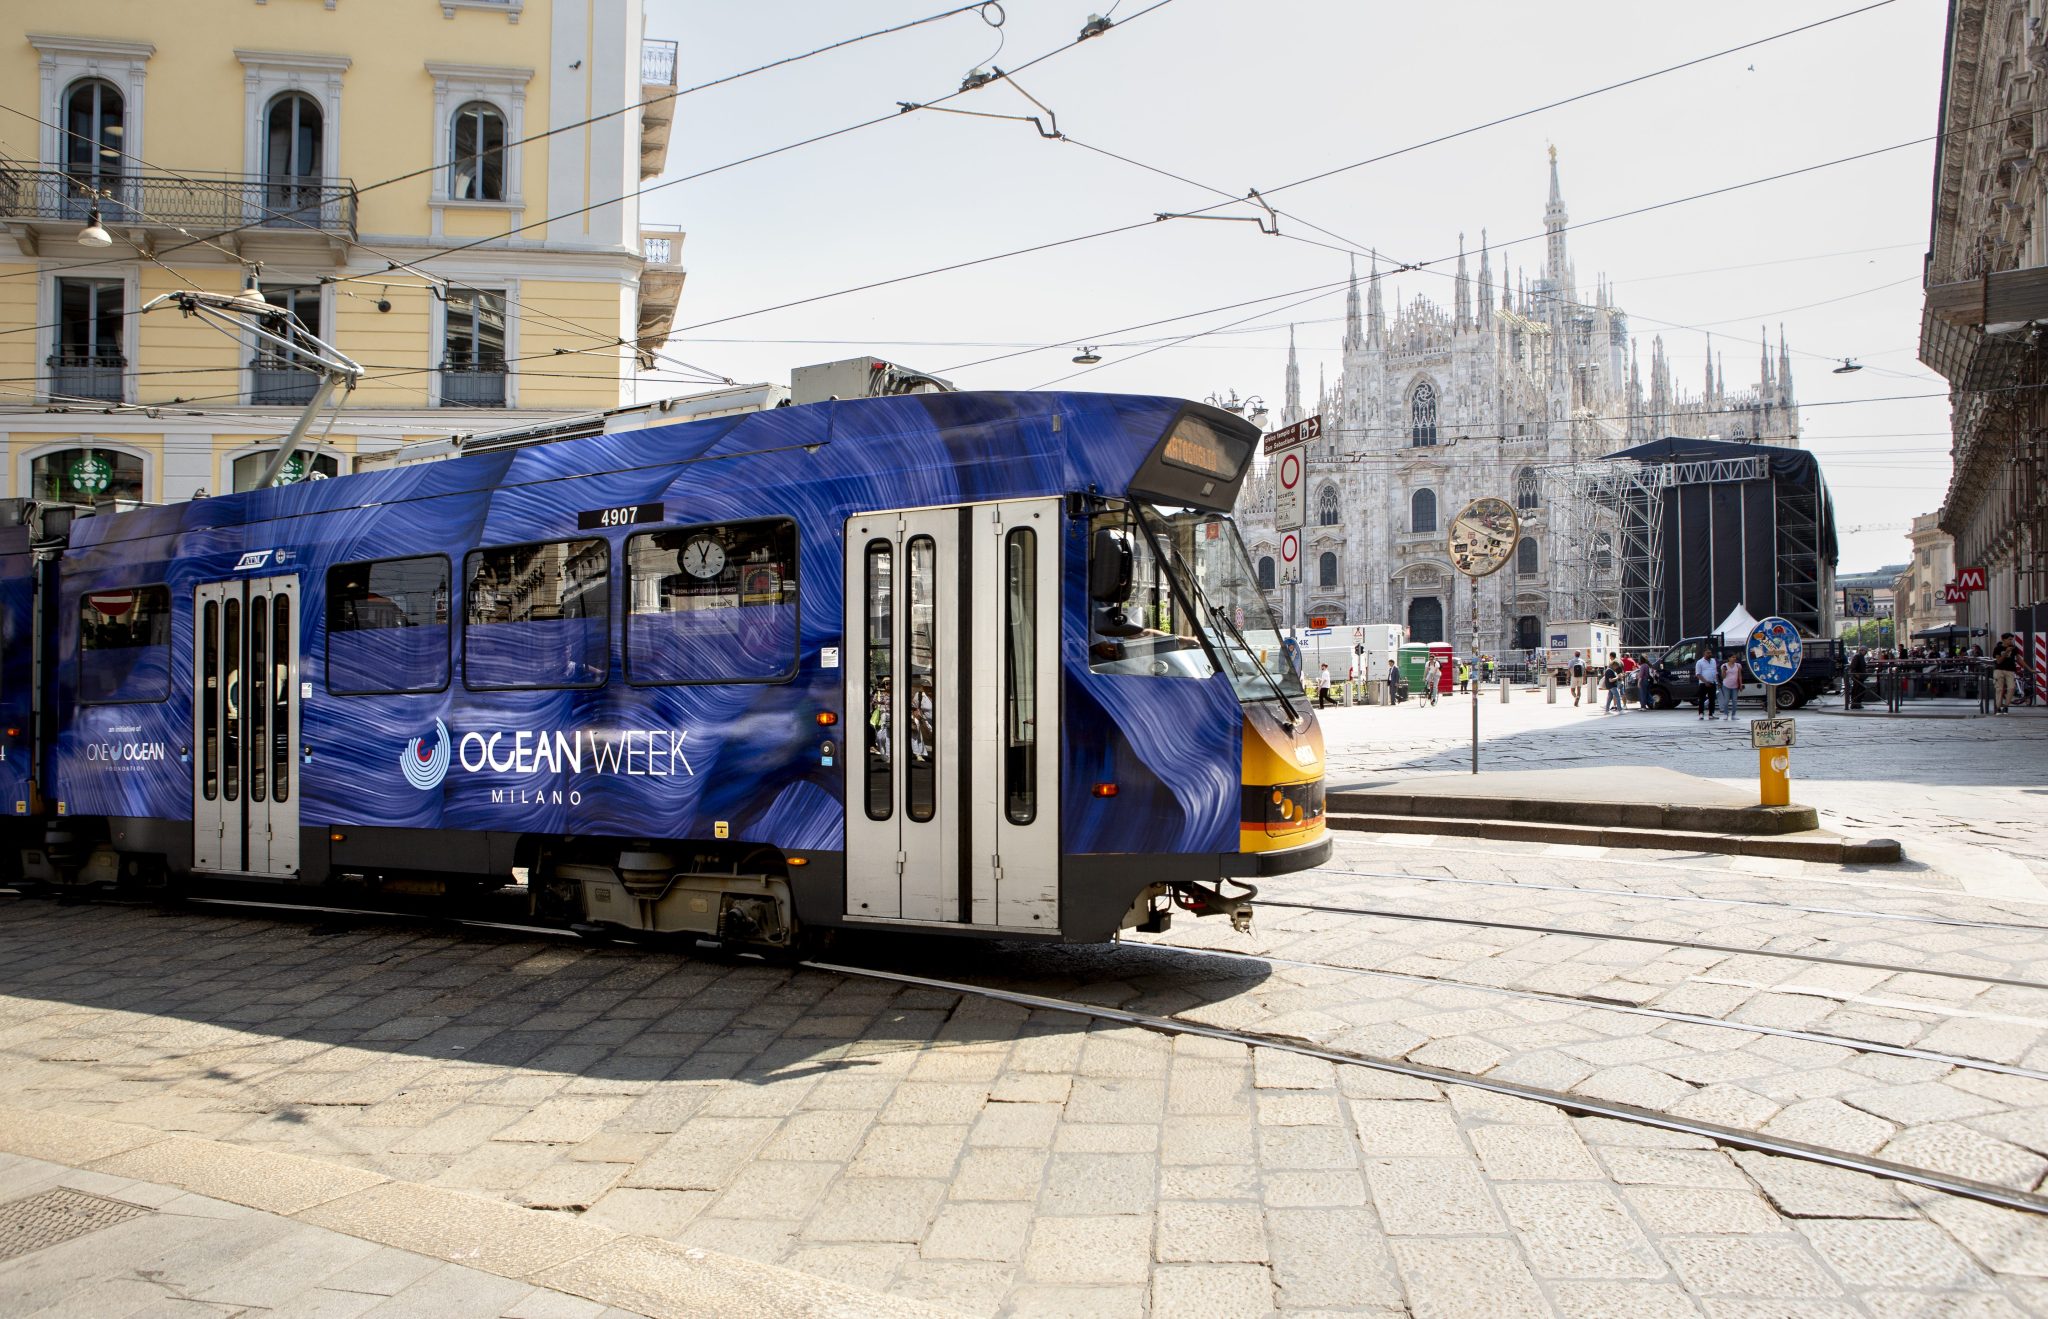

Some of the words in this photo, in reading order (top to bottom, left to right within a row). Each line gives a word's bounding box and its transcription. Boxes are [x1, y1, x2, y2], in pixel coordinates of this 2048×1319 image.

[601, 506, 638, 527] 4907
[244, 555, 261, 566] ATM
[1960, 572, 1983, 587] M
[1947, 588, 1966, 600] M
[1552, 638, 1567, 647] Rai
[115, 725, 135, 733] initiative
[87, 743, 109, 761] ONE
[123, 742, 165, 761] OCEAN
[459, 730, 582, 774] OCEAN
[589, 730, 694, 776] WEEK
[491, 789, 582, 806] MILANO
